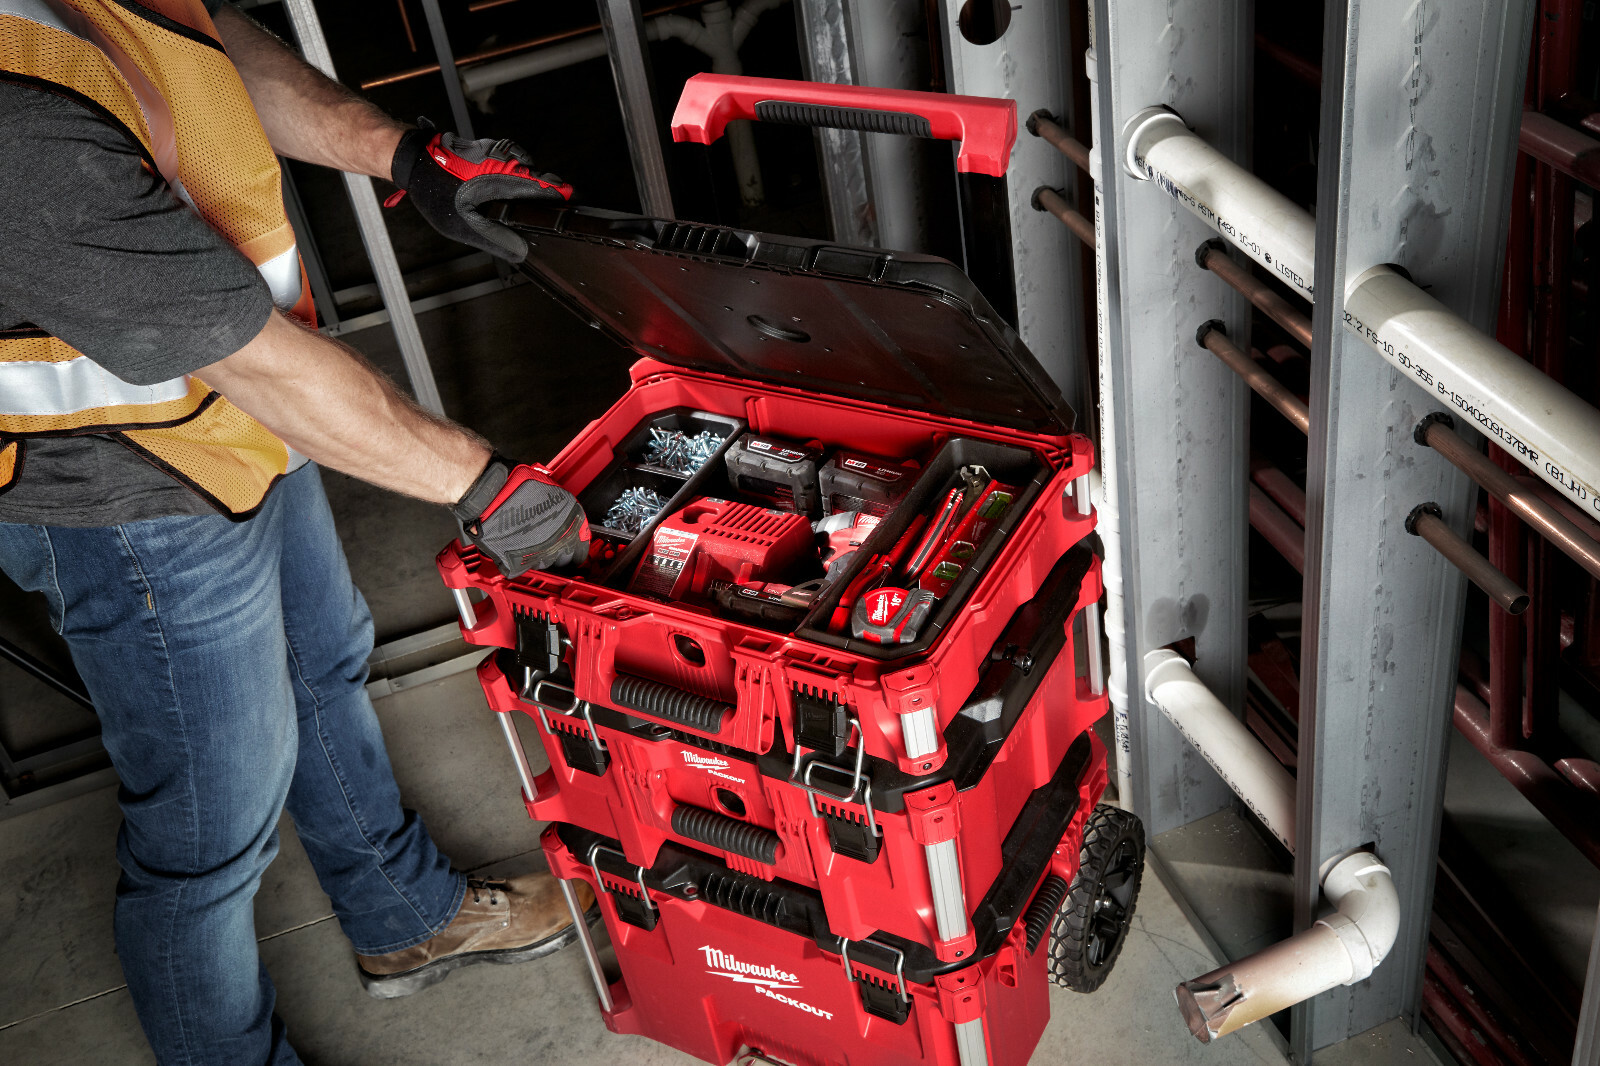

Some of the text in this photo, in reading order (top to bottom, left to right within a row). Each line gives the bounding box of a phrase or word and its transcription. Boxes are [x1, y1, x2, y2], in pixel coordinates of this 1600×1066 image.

[1275, 259, 1305, 288] LISTED
[1366, 328, 1394, 357] FS-10
[1398, 352, 1434, 386] SD-355
[493, 491, 566, 533] Milwaukee
[872, 594, 885, 621] Milwaukee
[680, 750, 729, 766] Milwaukee
[707, 768, 746, 784] PACKOUT
[698, 945, 800, 984] Milwaukee
[754, 985, 834, 1021] PACKOUT
